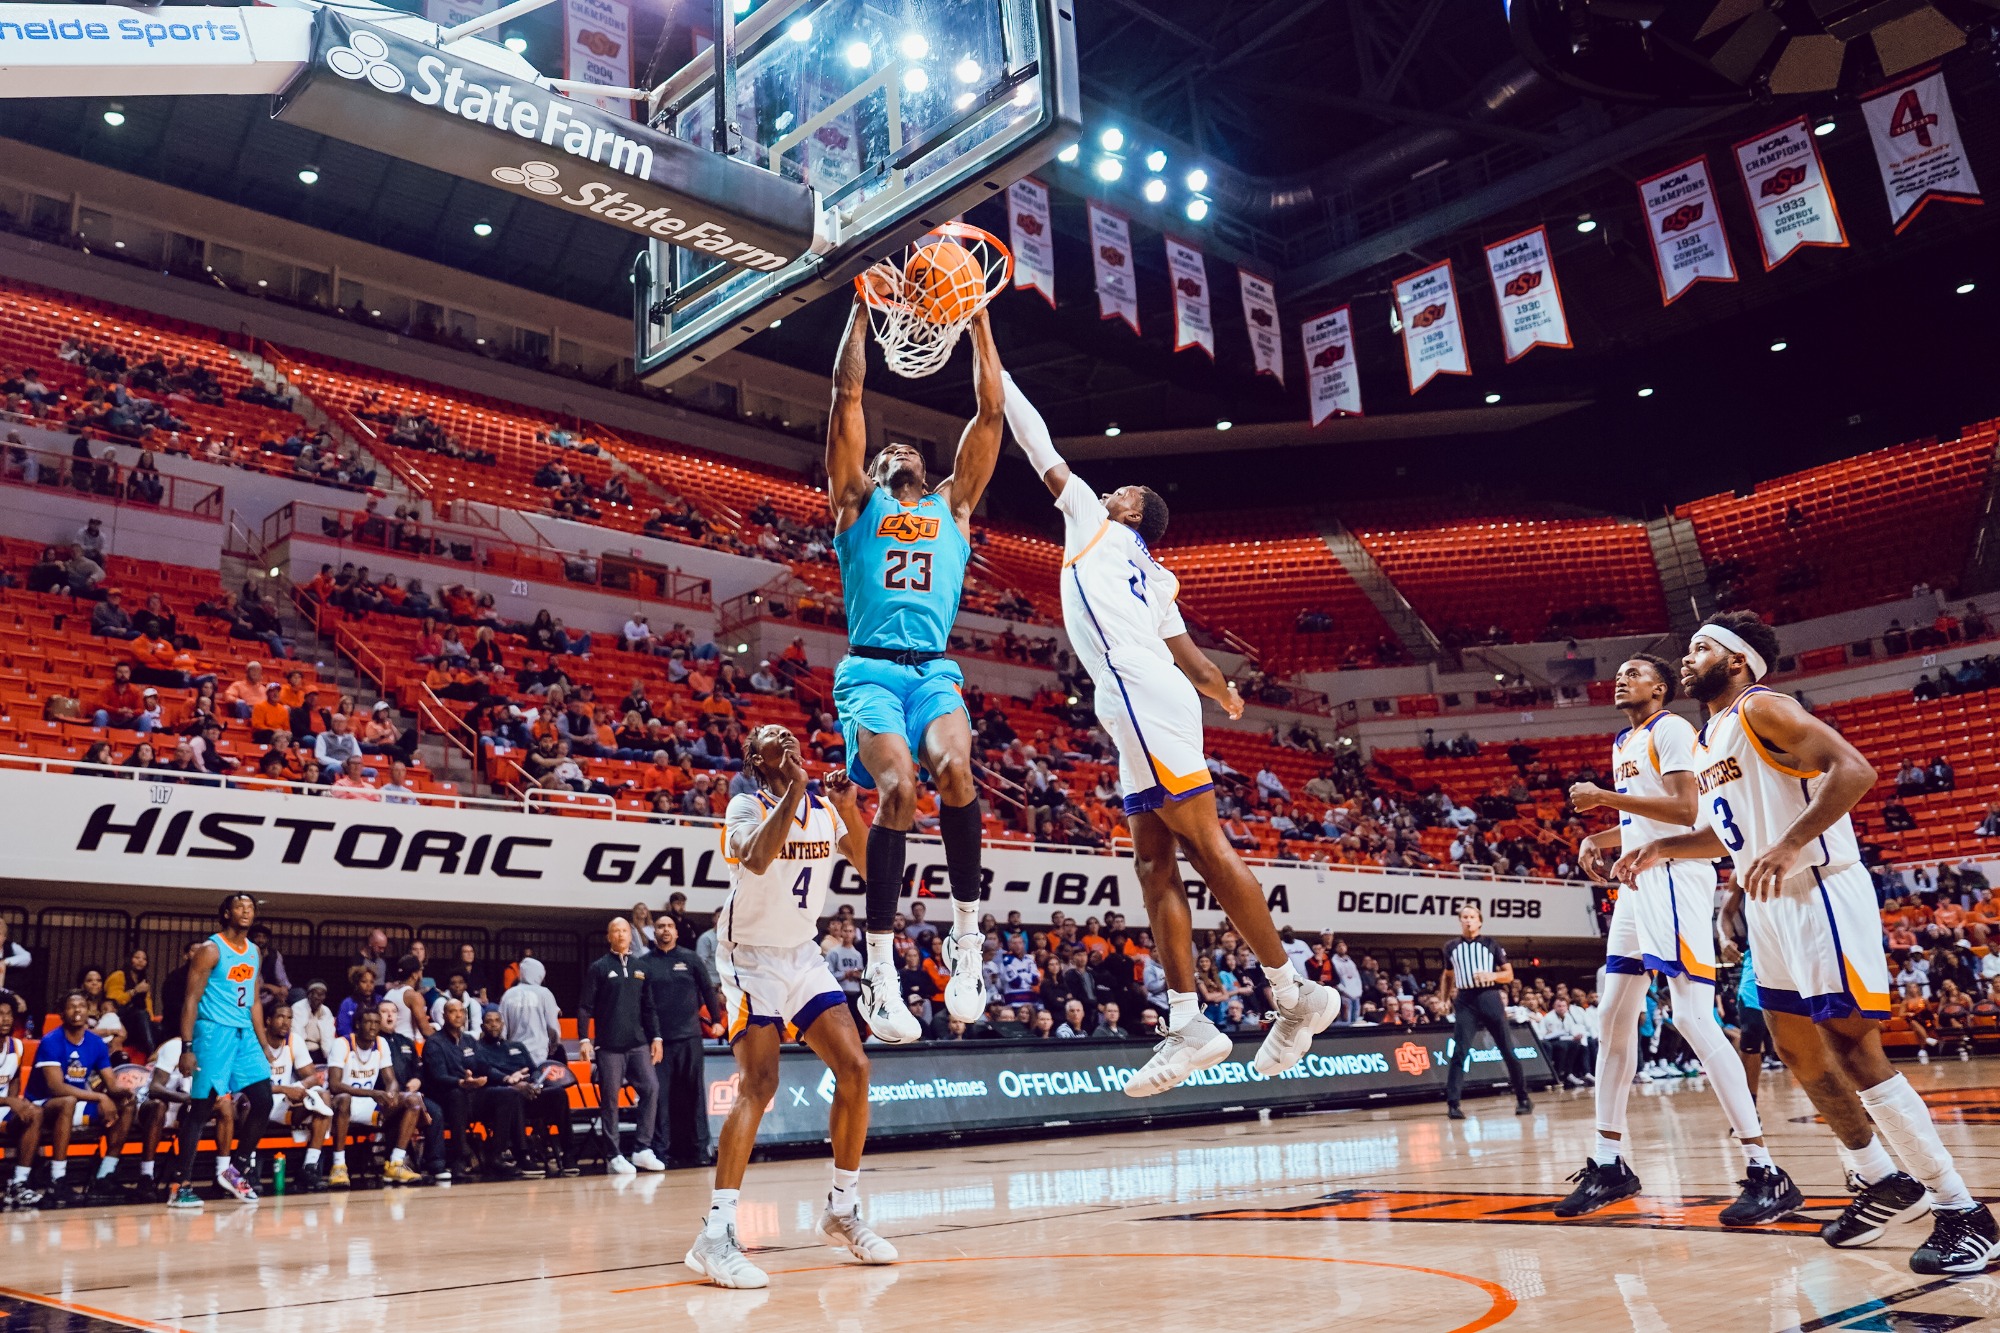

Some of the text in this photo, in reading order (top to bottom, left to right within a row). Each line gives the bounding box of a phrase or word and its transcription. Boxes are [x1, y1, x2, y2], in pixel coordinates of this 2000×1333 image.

[118, 18, 241, 47] Sports
[1889, 89, 1938, 147] 4
[1745, 140, 1808, 172] CHAMPIONS
[1757, 135, 1790, 155] NCAA
[1648, 178, 1706, 208] CHAMPIONS
[1660, 173, 1689, 192] NCAA
[1775, 206, 1813, 227] COWBOY
[1776, 196, 1807, 215] 1933
[1774, 214, 1820, 235] WRESTLING
[1503, 242, 1530, 258] NCAA
[1673, 243, 1709, 263] COWBOY
[1676, 233, 1702, 251] 1931
[1493, 247, 1544, 273] CHAMPIONS
[1673, 249, 1715, 270] WRESTLING
[1402, 281, 1449, 305] AMPIONS
[1412, 276, 1436, 291] NCAA
[1504, 270, 1543, 298] OSU
[876, 511, 940, 543] OSU
[884, 549, 934, 592] 23
[1695, 756, 1743, 795] ANTHERS
[151, 785, 173, 804] 107
[1713, 796, 1745, 852] 3
[76, 804, 553, 879] HISTORIC
[791, 866, 812, 909] 4
[1490, 898, 1541, 919] 1938
[237, 986, 247, 1008] 2
[1394, 1041, 1431, 1076] OSU
[932, 1078, 988, 1098] Homes
[998, 1070, 1102, 1099] OFFICIAL
[1305, 1052, 1389, 1078] COWBOYS
